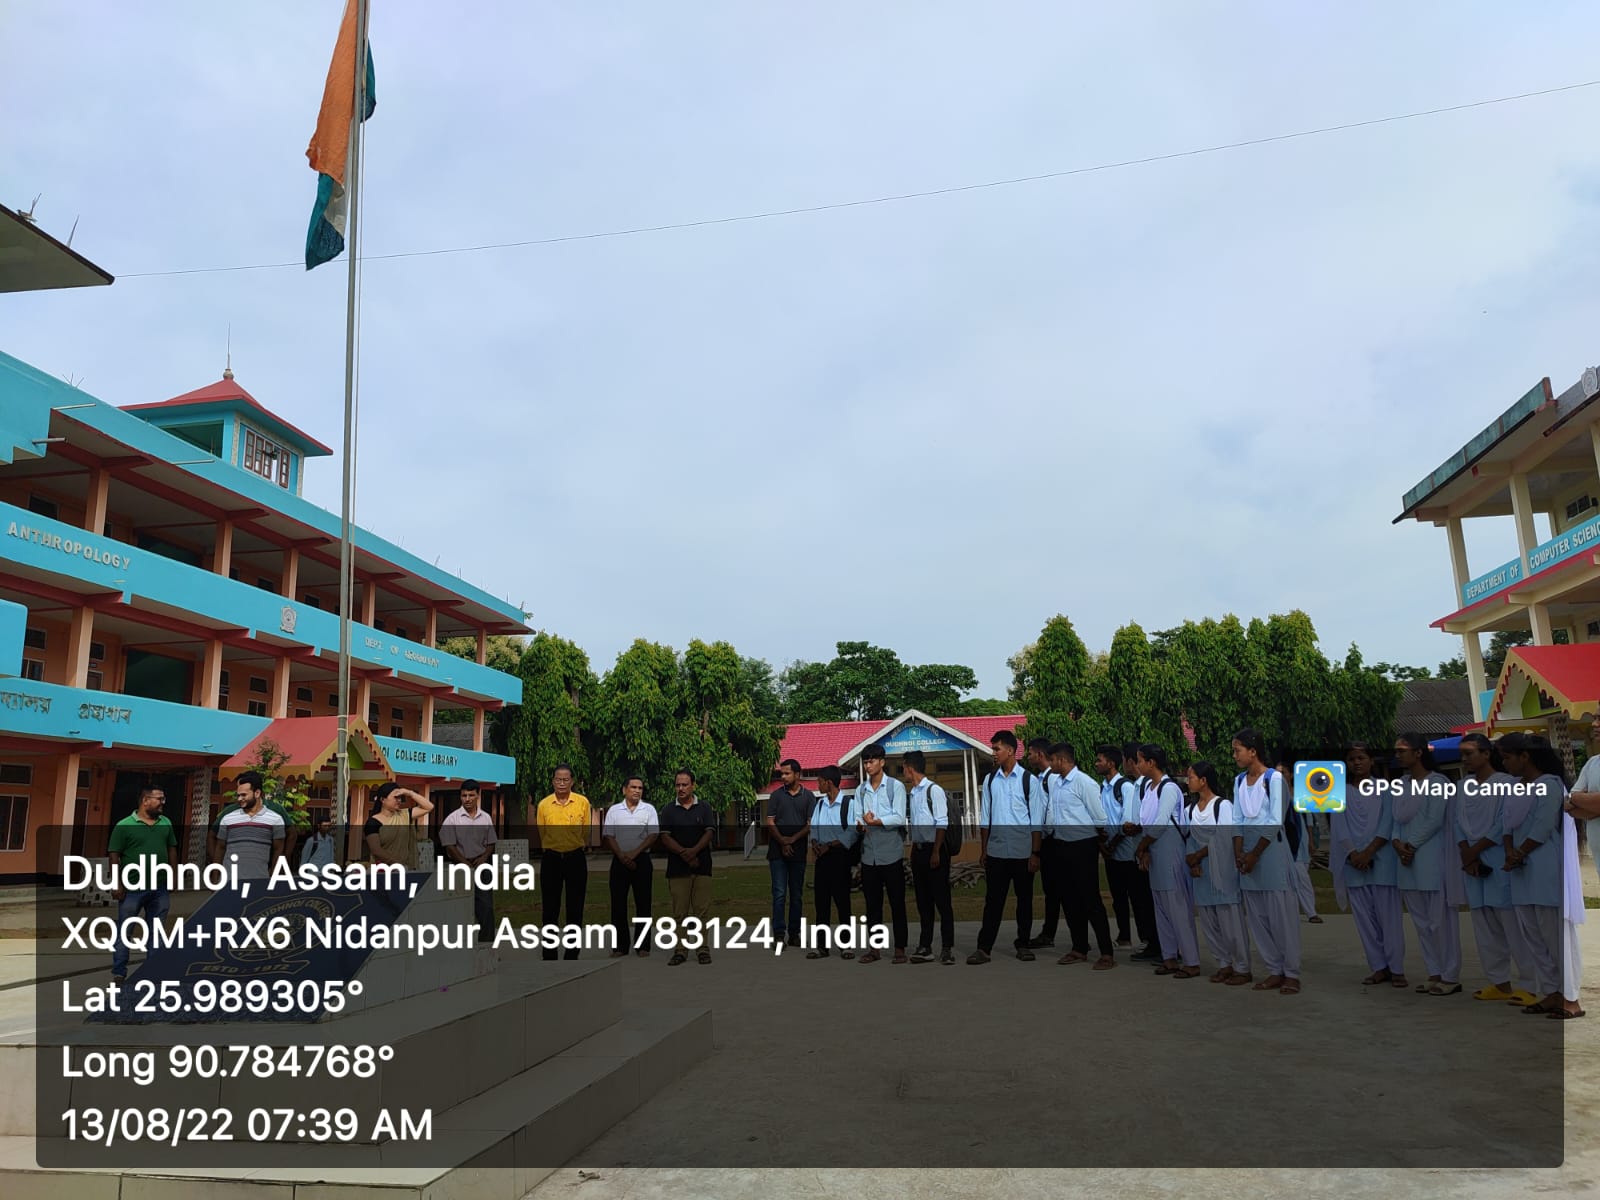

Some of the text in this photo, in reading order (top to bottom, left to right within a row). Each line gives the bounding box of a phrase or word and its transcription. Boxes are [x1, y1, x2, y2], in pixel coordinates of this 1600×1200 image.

[7, 521, 131, 571] ANTHROPOLOGY
[1467, 571, 1507, 598] DEPARTMENT
[1510, 564, 1519, 578] OF
[1530, 537, 1570, 569] COMPUTER
[395, 748, 426, 763] COLLEGE
[430, 753, 458, 768] LIBRARY
[917, 738, 946, 746] COLLEGE
